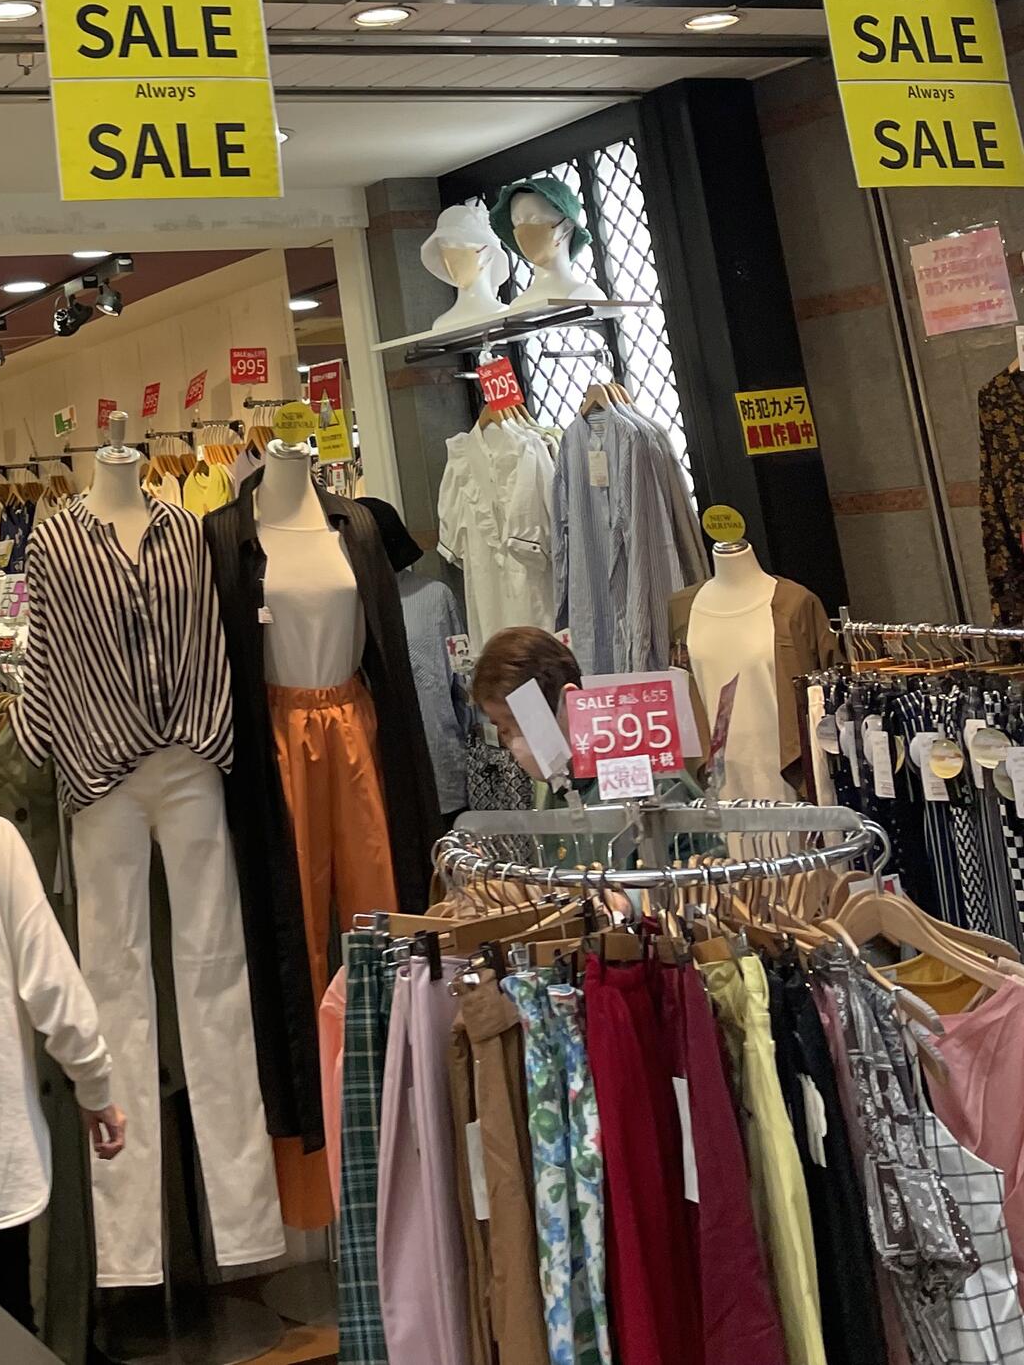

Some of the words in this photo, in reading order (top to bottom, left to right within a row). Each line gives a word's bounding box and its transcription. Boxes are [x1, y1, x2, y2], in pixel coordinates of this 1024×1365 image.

[76, 4, 238, 59] SALE
[853, 15, 984, 64] SALE
[135, 83, 196, 101] Always
[907, 85, 955, 101] Always
[88, 123, 251, 180] SALE
[874, 120, 1006, 170] SALE
[740, 395, 805, 421] 防犯カメラ
[576, 695, 615, 711] SALE
[575, 710, 673, 755] ¥595
[649, 751, 675, 767] +税
